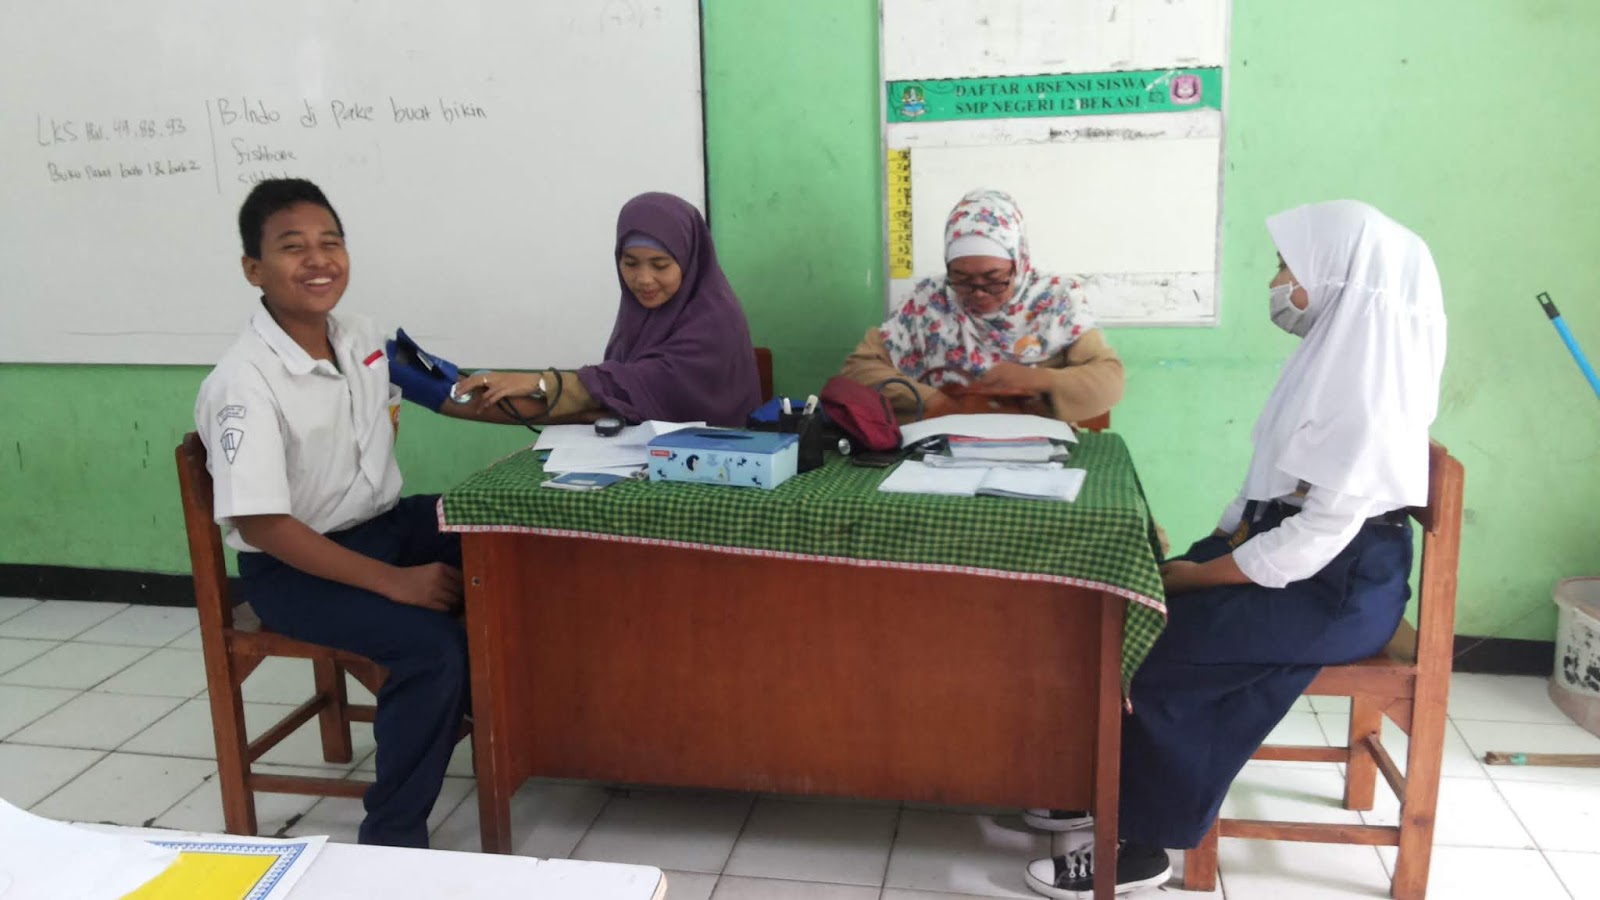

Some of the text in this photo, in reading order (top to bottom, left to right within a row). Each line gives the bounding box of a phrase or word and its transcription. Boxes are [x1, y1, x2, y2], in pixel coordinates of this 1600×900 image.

[955, 77, 1147, 98] DAFTAR ABSENSI SISWA
[955, 95, 1141, 115] SMP NEGERI 12 BEKASI
